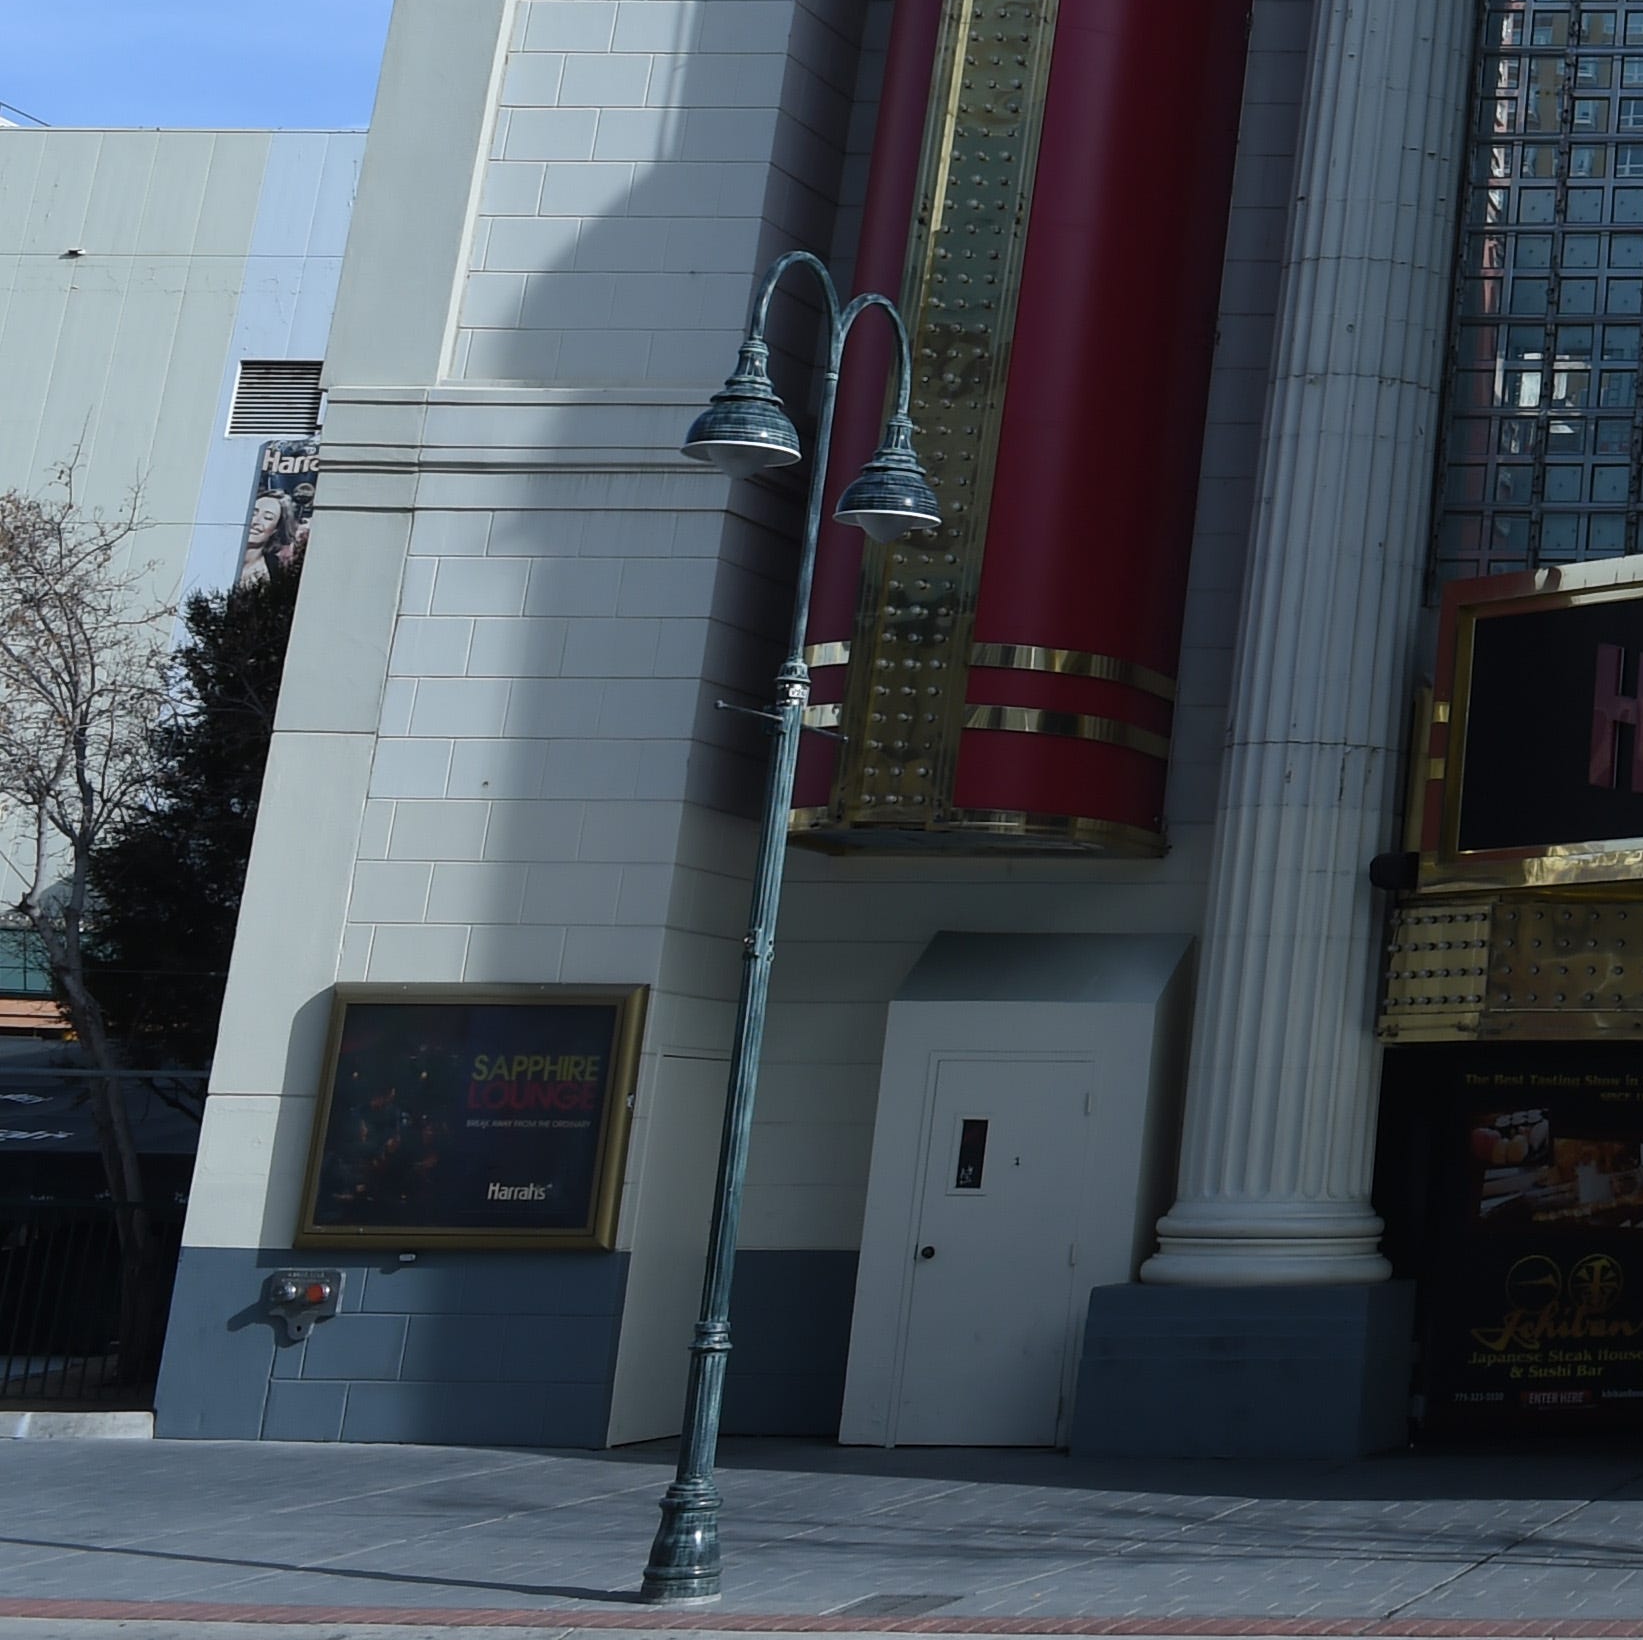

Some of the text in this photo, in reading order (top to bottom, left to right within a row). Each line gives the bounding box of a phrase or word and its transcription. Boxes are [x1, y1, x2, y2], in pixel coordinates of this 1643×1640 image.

[472, 1054, 601, 1081] SAPPHIRE
[466, 1081, 597, 1111] LOUNGE
[1468, 1350, 1543, 1367] Japanese
[1547, 1349, 1593, 1363] Steak
[1508, 1363, 1606, 1379] & Sushi Bar
[1528, 1391, 1585, 1405] ENTER HERE
